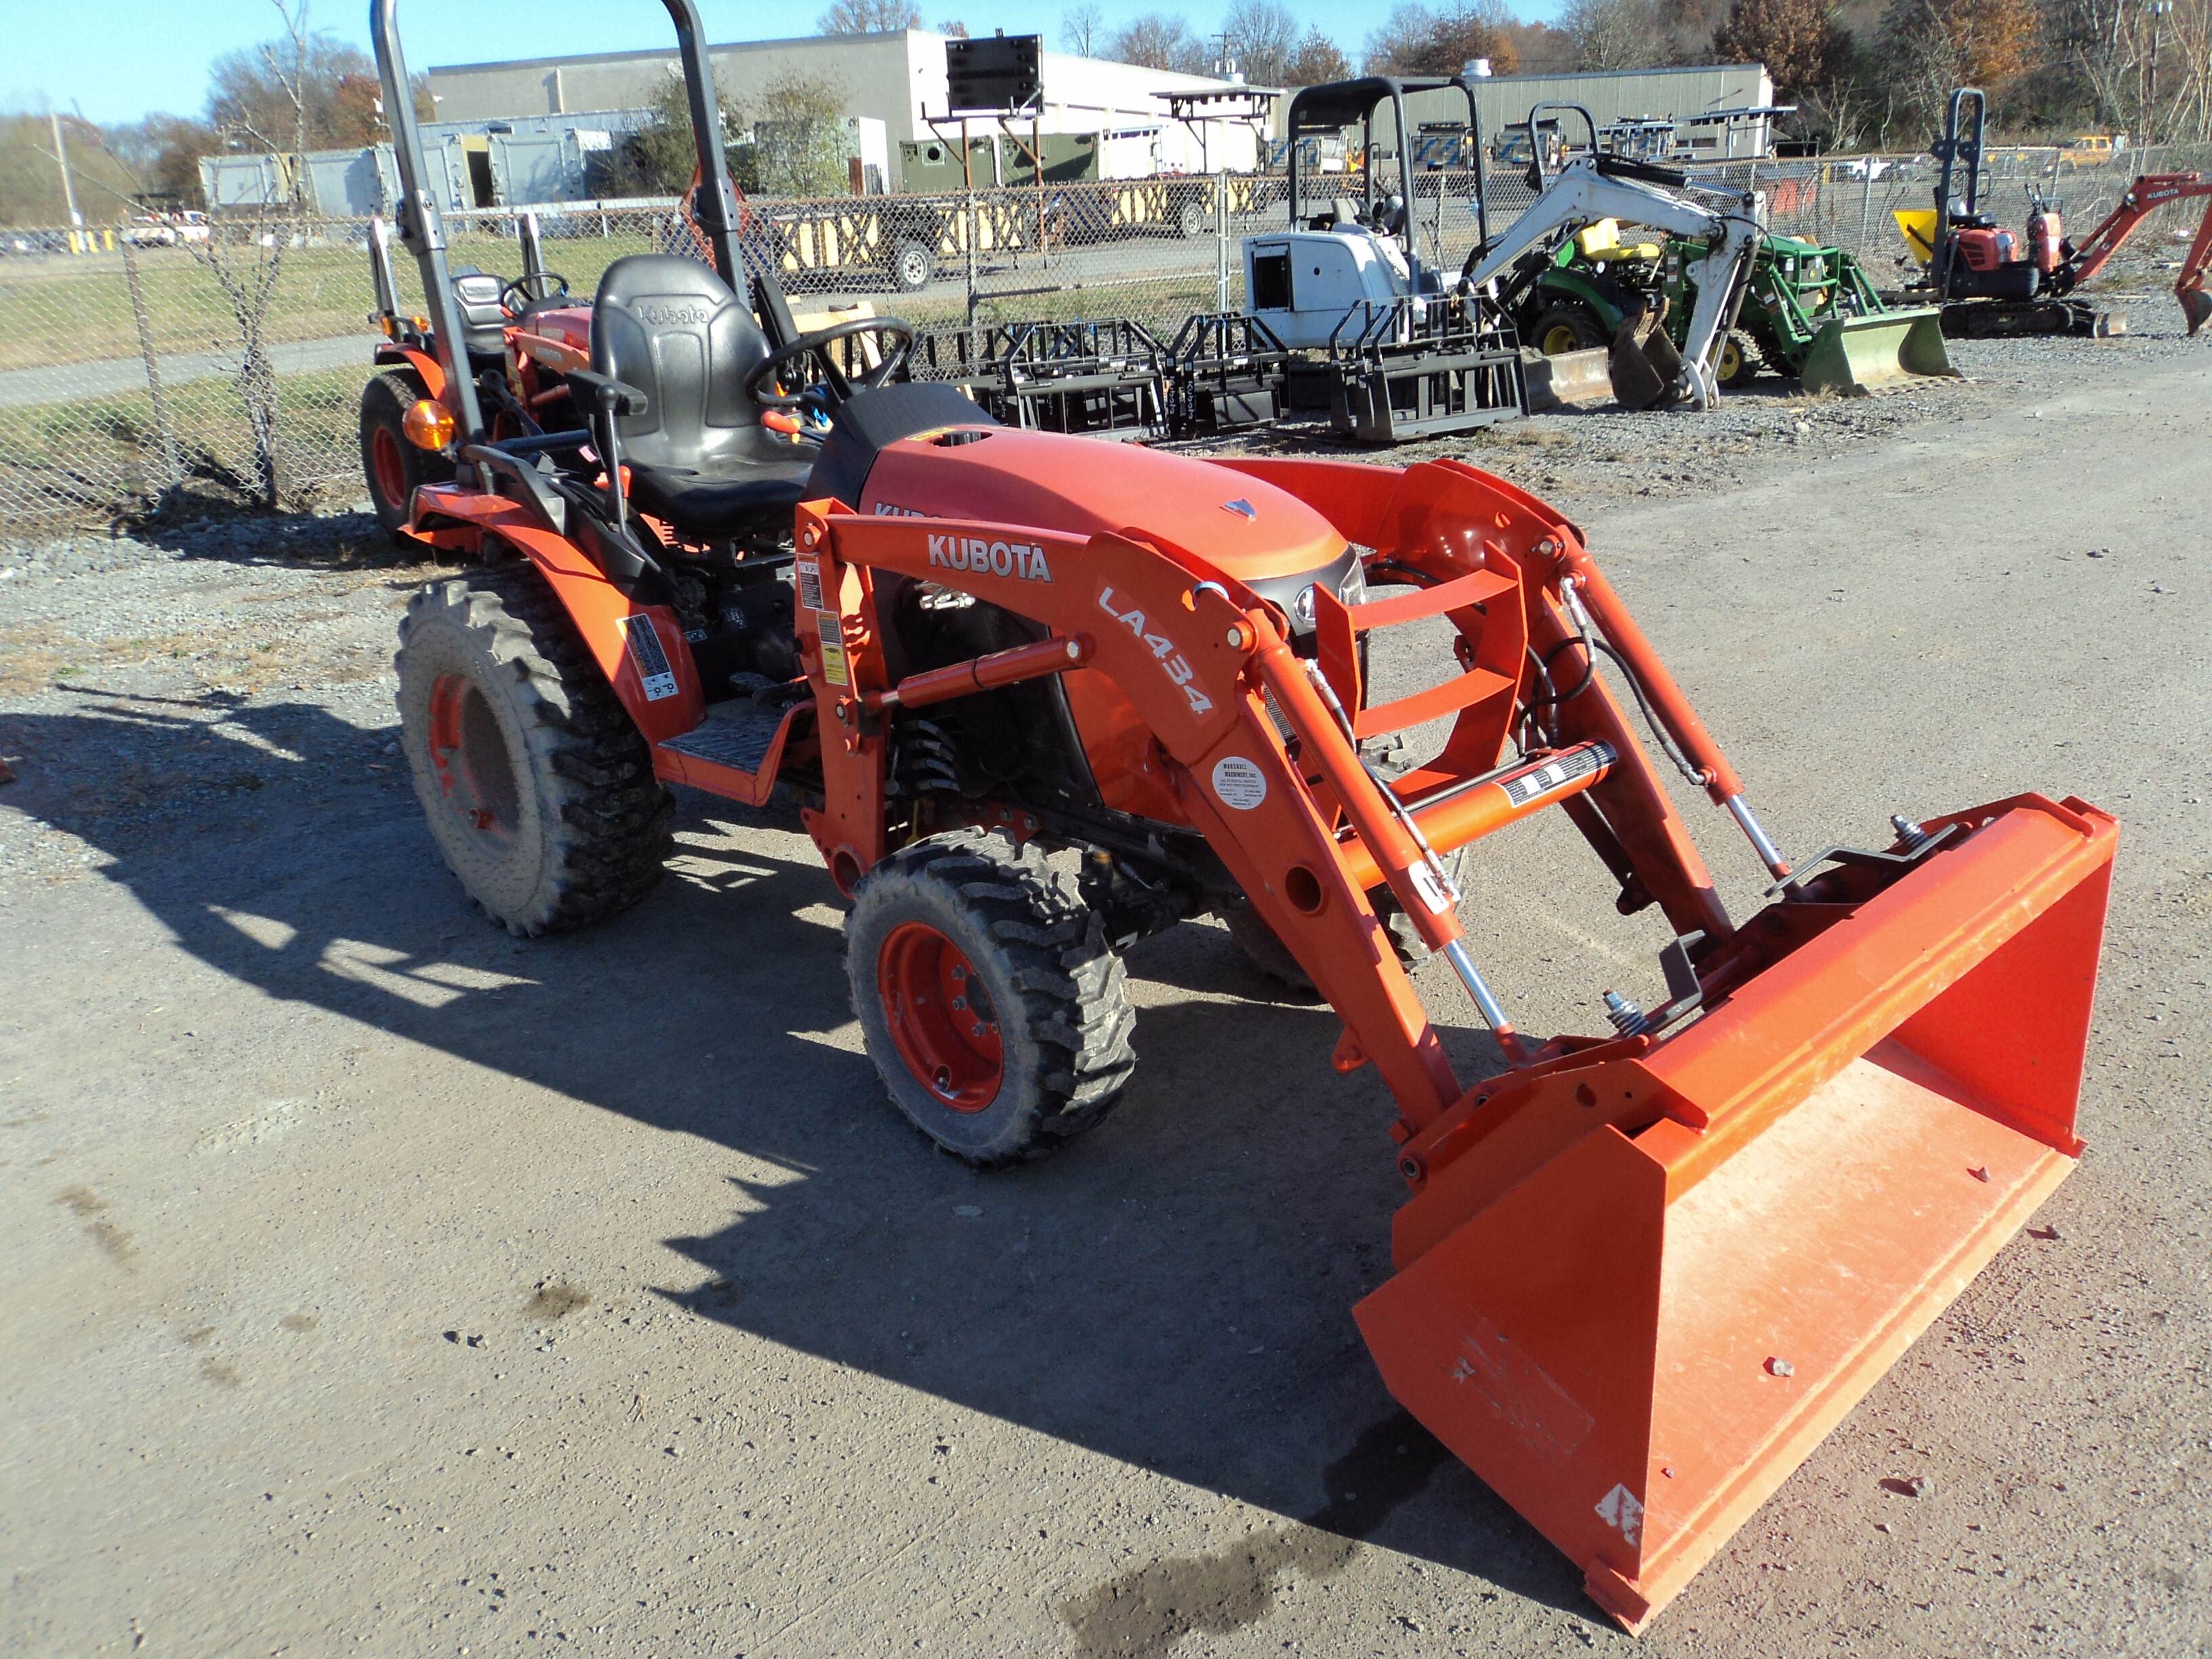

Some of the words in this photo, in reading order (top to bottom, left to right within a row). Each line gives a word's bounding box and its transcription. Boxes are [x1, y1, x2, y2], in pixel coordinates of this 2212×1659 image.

[2147, 188, 2179, 199] KUBOTA
[638, 306, 708, 325] Kubota
[928, 533, 1053, 583] KUBOTA
[1099, 586, 1213, 715] LA434
